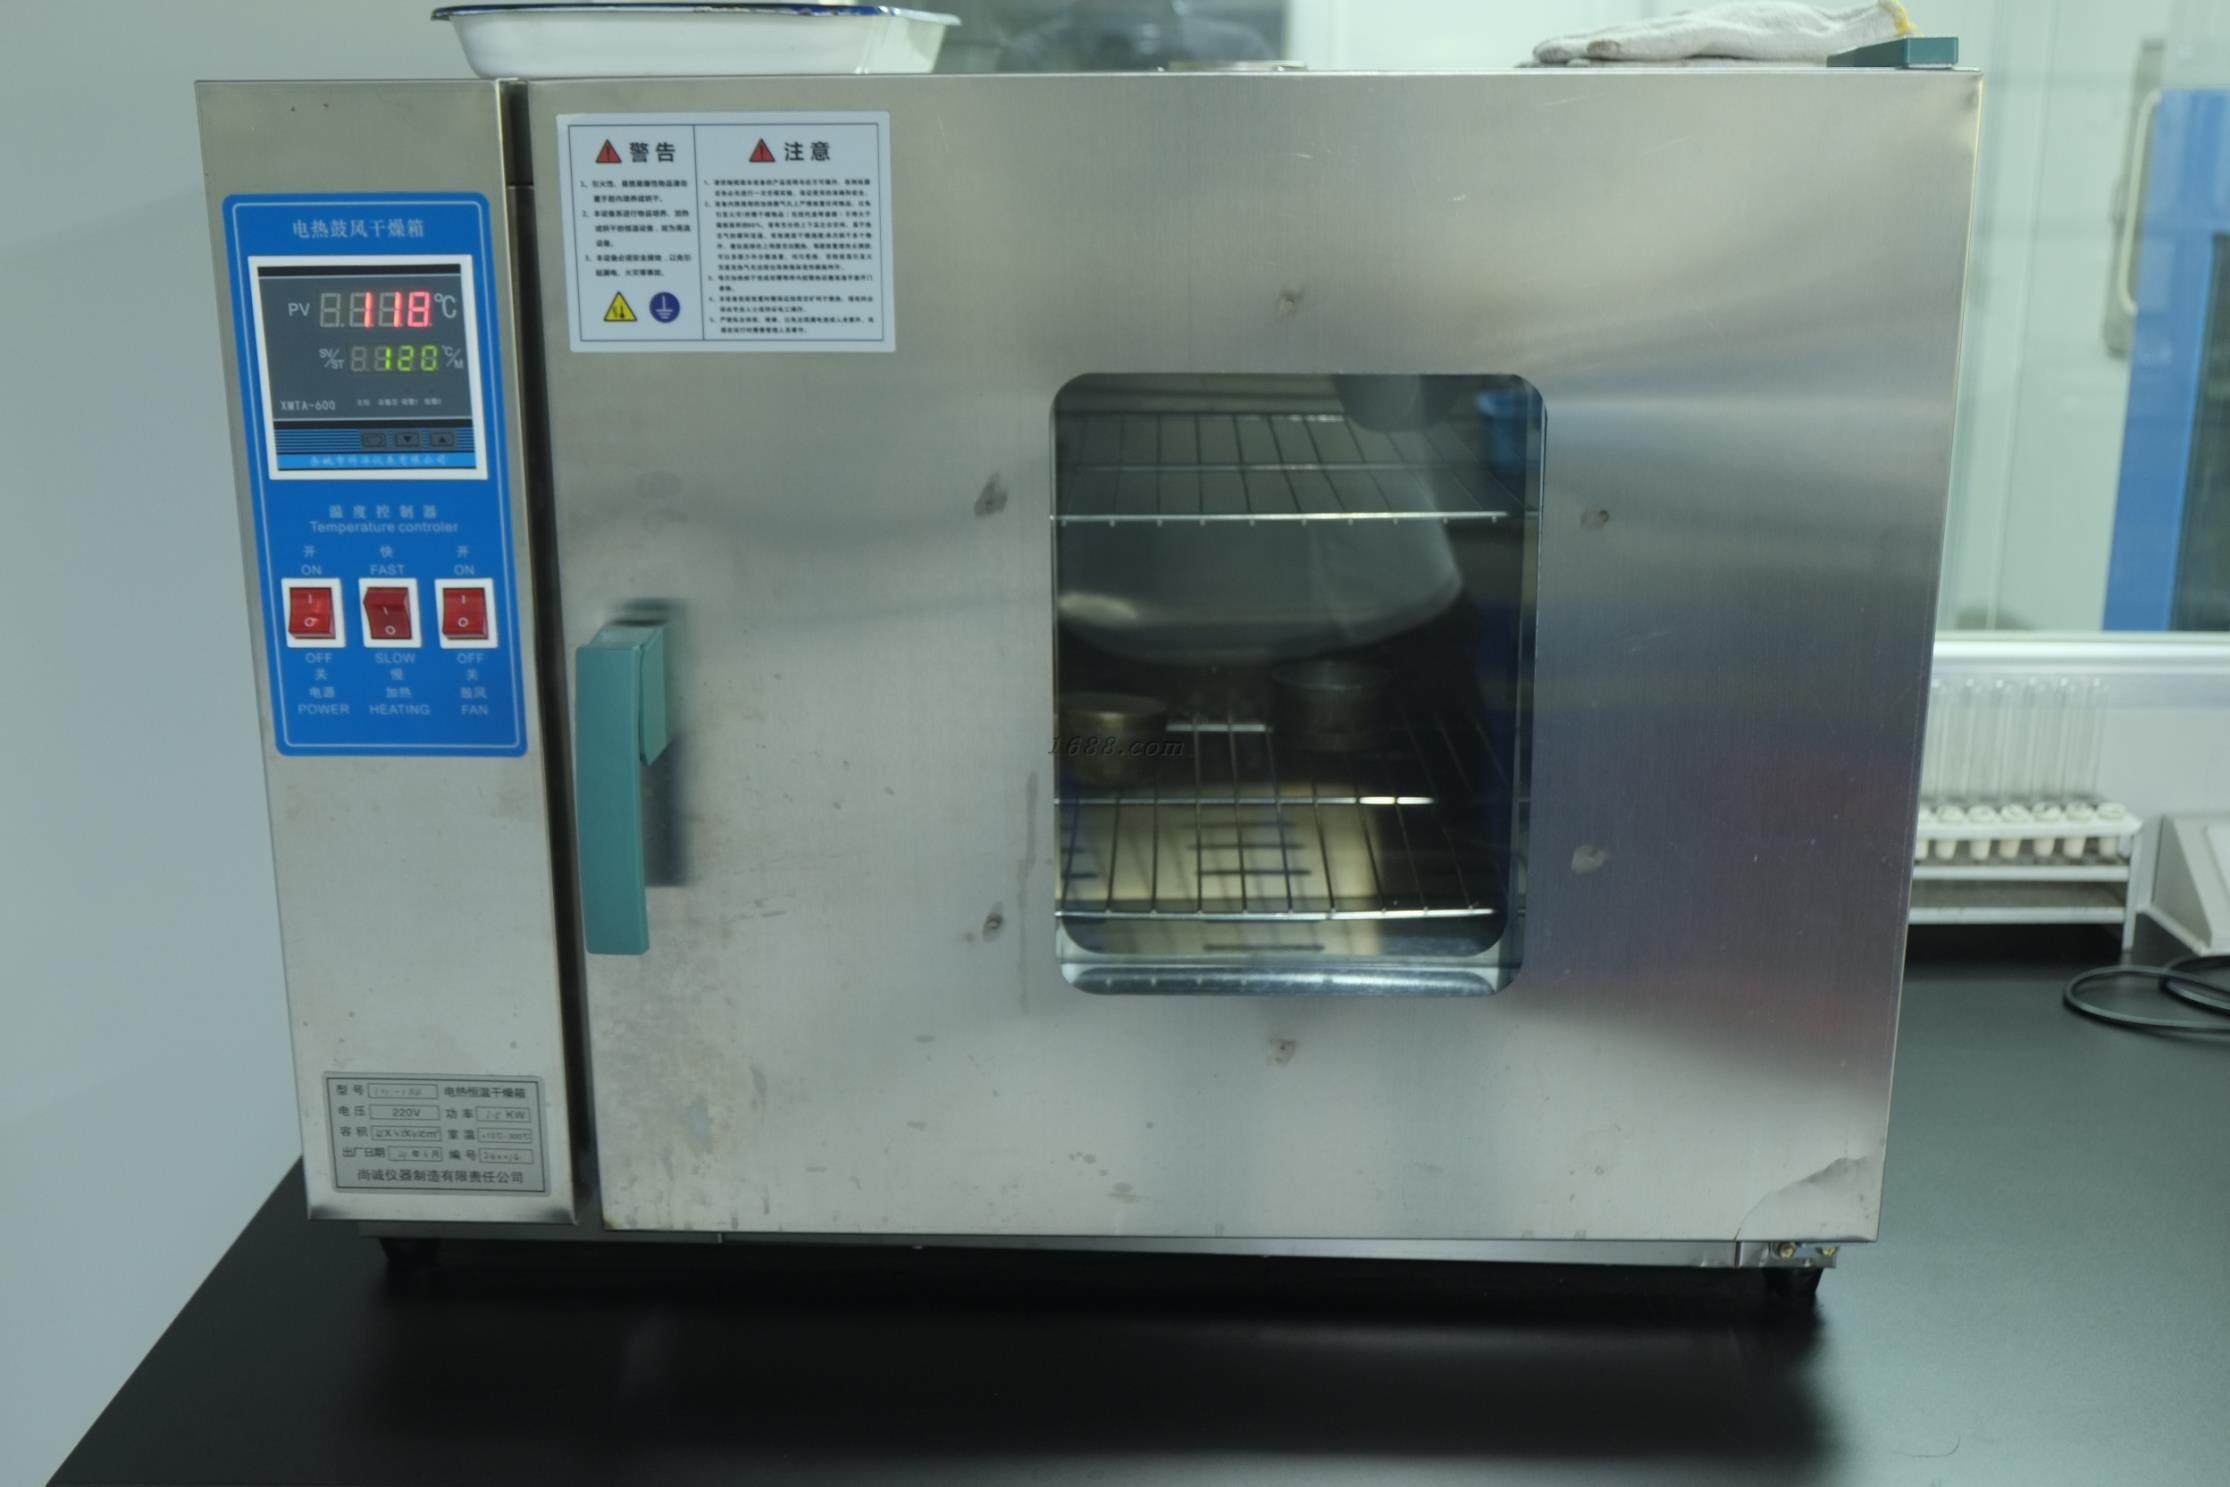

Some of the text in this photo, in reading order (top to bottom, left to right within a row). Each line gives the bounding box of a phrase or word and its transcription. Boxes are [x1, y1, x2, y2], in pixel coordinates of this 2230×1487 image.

[629, 141, 676, 163] 警告
[784, 141, 831, 162] 注意
[292, 219, 425, 239] 电热鼓风干燥箱
[288, 302, 310, 317] PV
[382, 345, 438, 372] 120
[280, 399, 336, 411] XMTA-600
[329, 504, 439, 519] 温度控制器
[310, 520, 459, 534] Temperature controler
[303, 545, 316, 557] 开
[380, 545, 394, 558] 快
[457, 546, 470, 558] 开
[301, 564, 322, 575] ON
[369, 564, 405, 575] FAST
[454, 564, 475, 576] ON
[305, 652, 333, 664] OFF
[375, 652, 415, 664] SLOW
[457, 653, 485, 664] OFF
[315, 669, 328, 680] 关
[466, 669, 479, 680] 关
[309, 686, 335, 699] 电源
[386, 686, 412, 699] 加热
[460, 686, 487, 699] 鼓风
[298, 703, 350, 715] POWER
[369, 703, 431, 715] HEATING
[461, 703, 489, 715] FAN
[336, 1084, 364, 1096] 型号
[338, 1106, 366, 1117] 电压
[392, 1107, 421, 1118] 220V
[445, 1108, 474, 1119] 功率
[506, 1110, 526, 1119] KW
[340, 1126, 368, 1137] 容积
[342, 1147, 385, 1158] 出厂日期
[357, 1168, 524, 1184] 尚诚仪器制造有限责任公司
